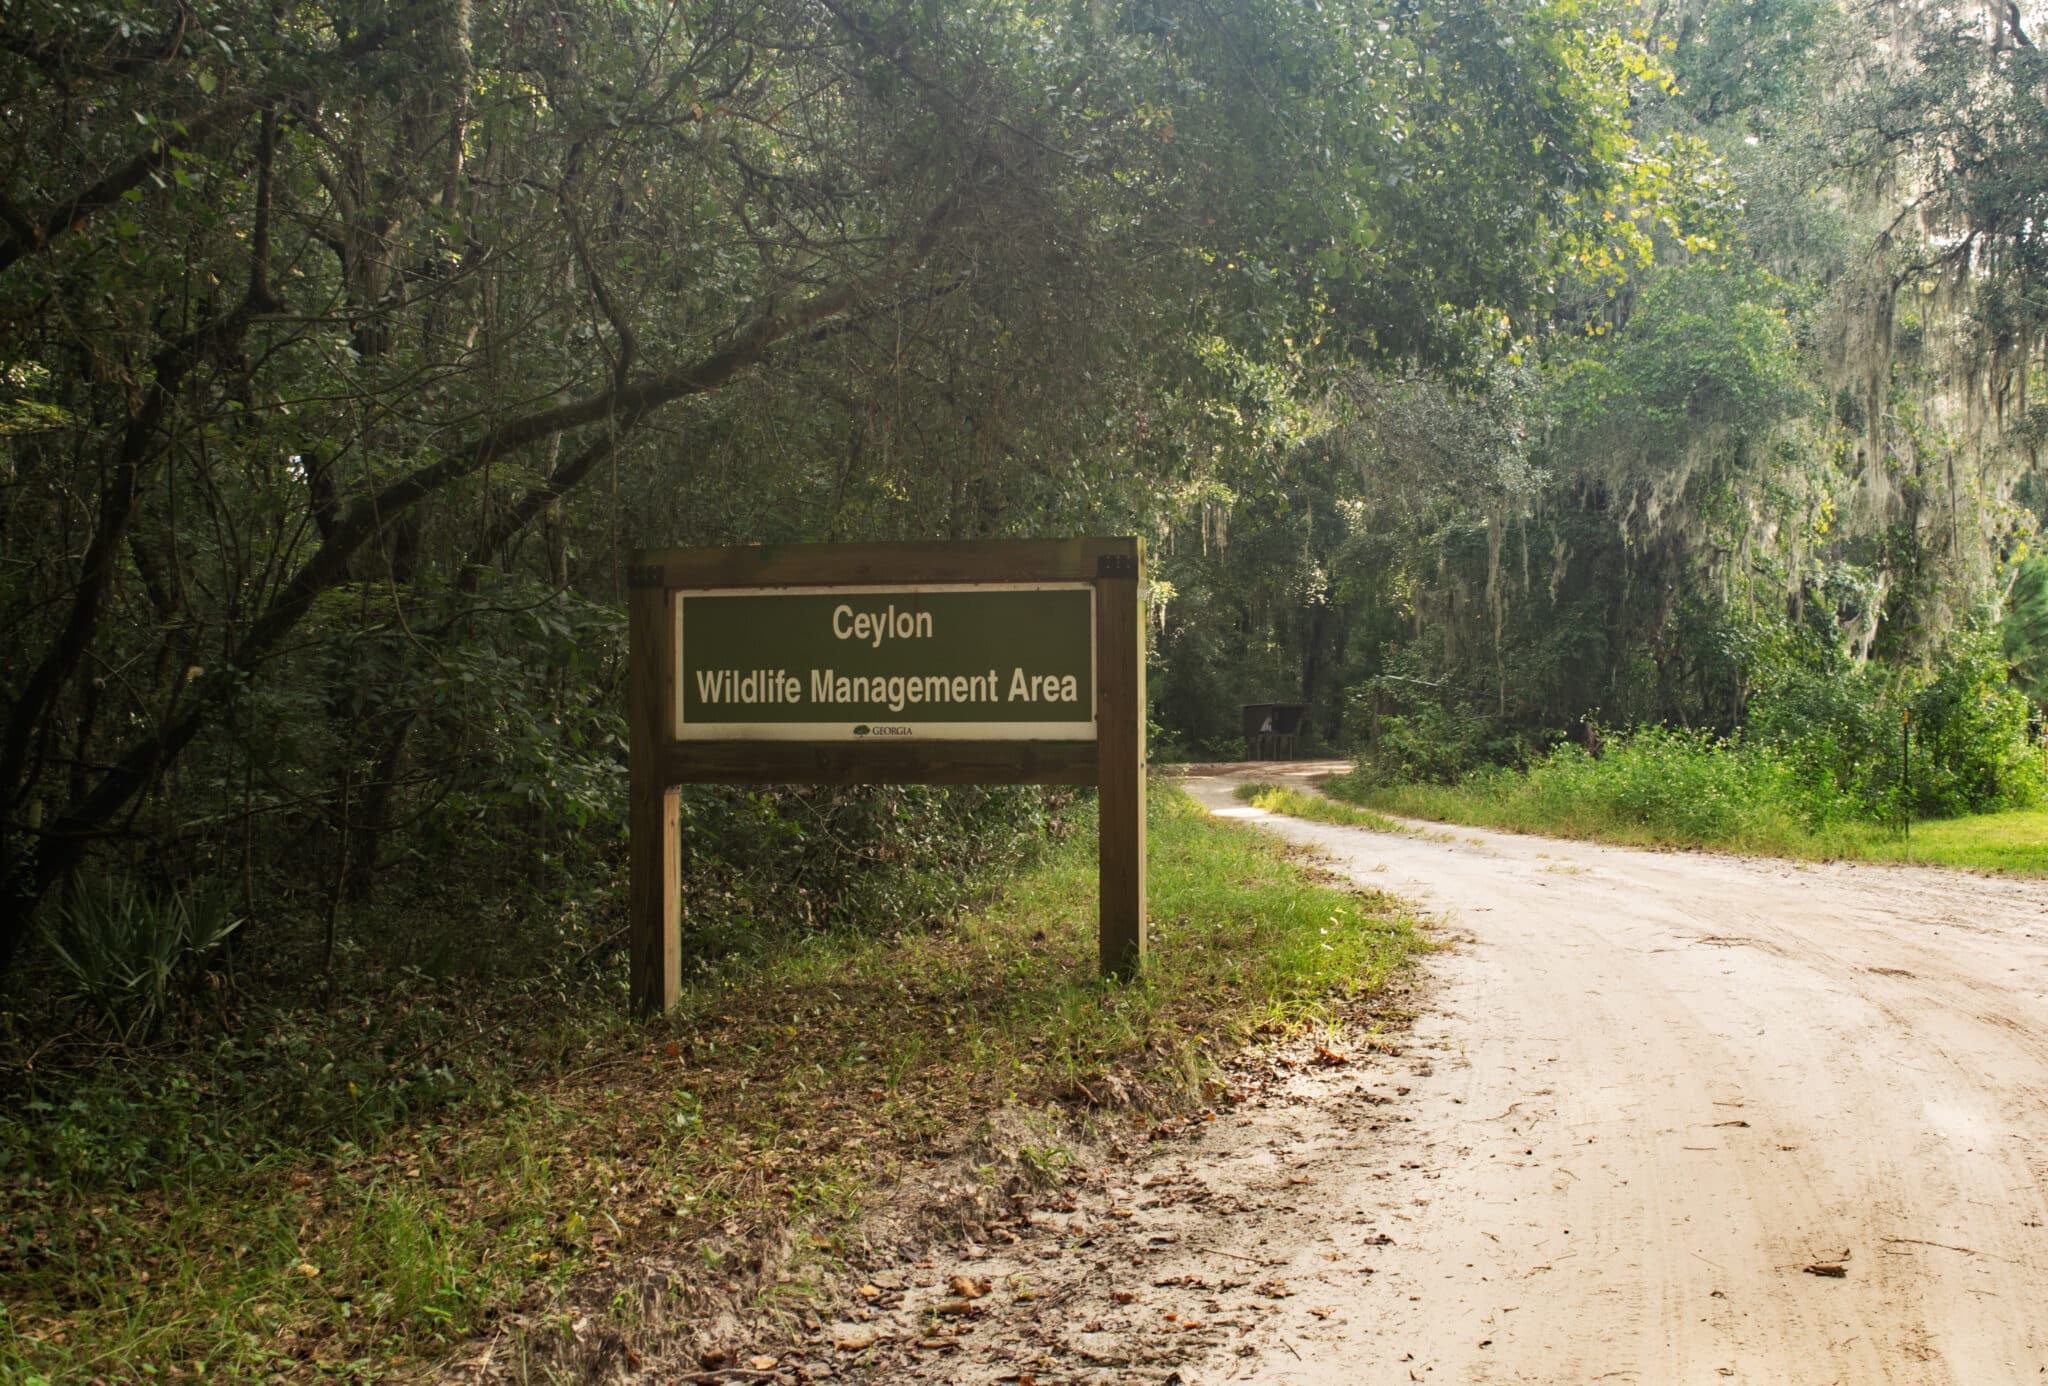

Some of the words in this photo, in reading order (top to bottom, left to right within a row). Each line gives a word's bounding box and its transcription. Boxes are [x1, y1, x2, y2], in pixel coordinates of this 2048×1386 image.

[833, 604, 933, 648] Ceylon
[696, 669, 802, 704] Wildlife
[810, 669, 999, 712] Management
[1007, 667, 1079, 703] Area
[872, 725, 913, 736] GEORGIA
